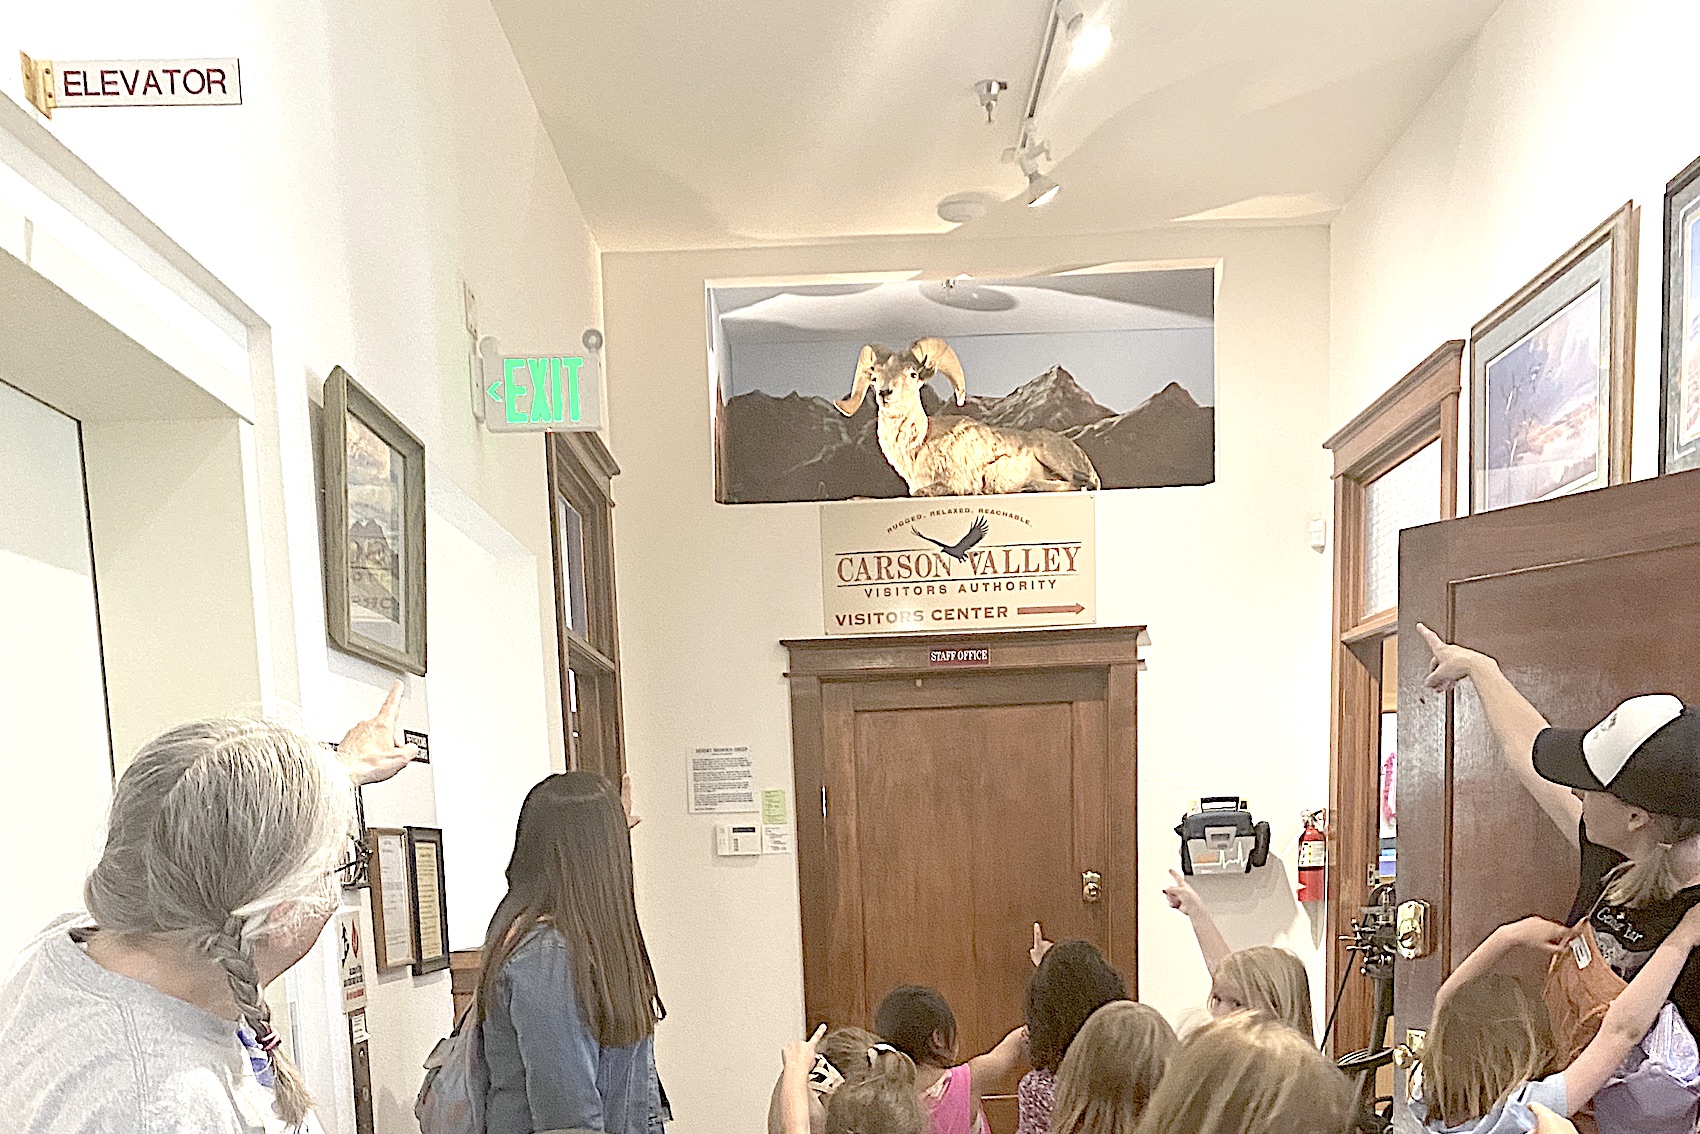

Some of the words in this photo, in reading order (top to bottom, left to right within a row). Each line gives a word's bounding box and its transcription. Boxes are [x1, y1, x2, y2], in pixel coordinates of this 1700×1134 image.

[63, 67, 227, 98] ELEVATOR
[503, 356, 584, 424] EXIT
[837, 553, 951, 582] CARSON
[967, 546, 1081, 576] VALLEY
[864, 584, 947, 598] VISITORS
[958, 579, 1057, 594] AUTHORITY
[835, 610, 924, 626] VISITORS
[931, 606, 1009, 621] CENTER
[930, 650, 957, 662] STAFF
[957, 649, 988, 661] OFFICE
